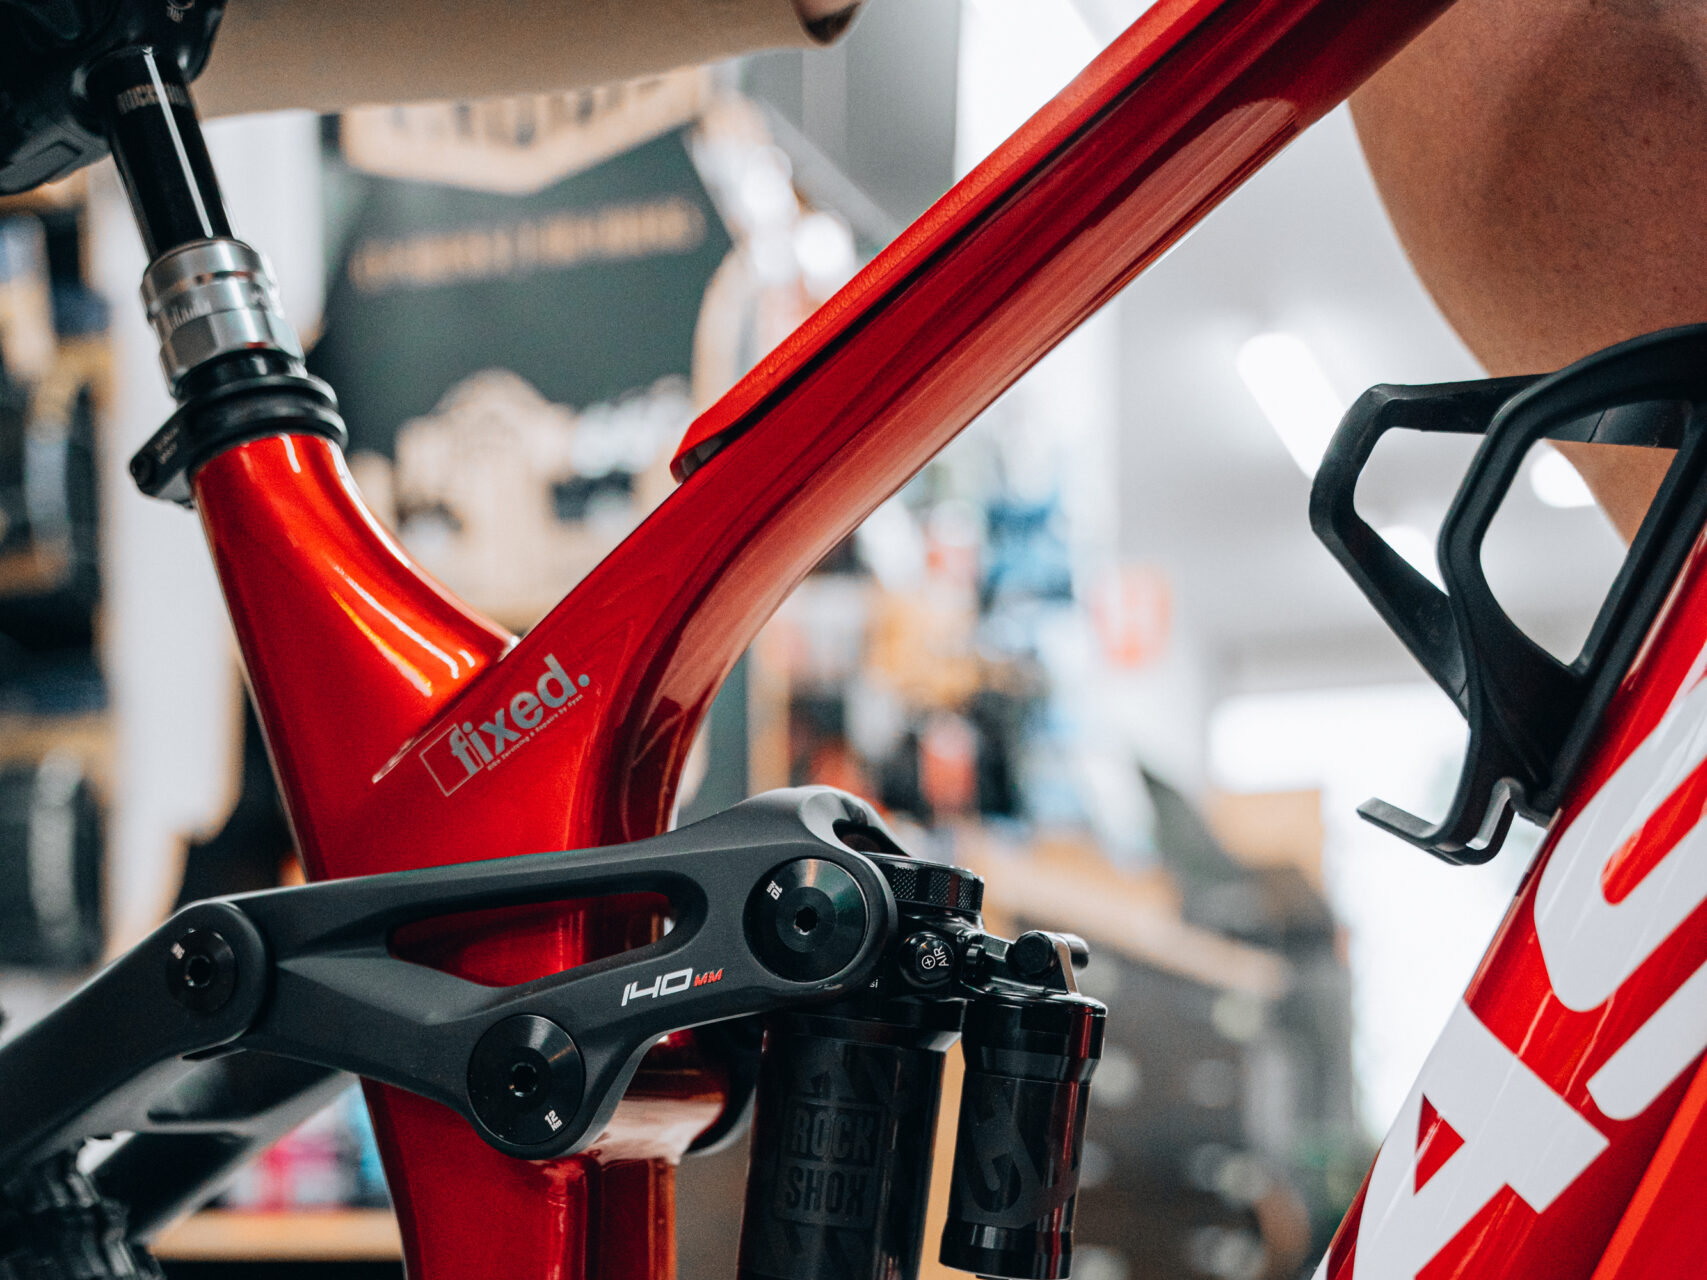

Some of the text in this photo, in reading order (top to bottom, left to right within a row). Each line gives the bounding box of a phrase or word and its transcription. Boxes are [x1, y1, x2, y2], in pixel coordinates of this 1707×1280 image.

[448, 652, 590, 775] fixed.
[932, 945, 949, 967] AIR
[790, 1108, 876, 1162] ROCK
